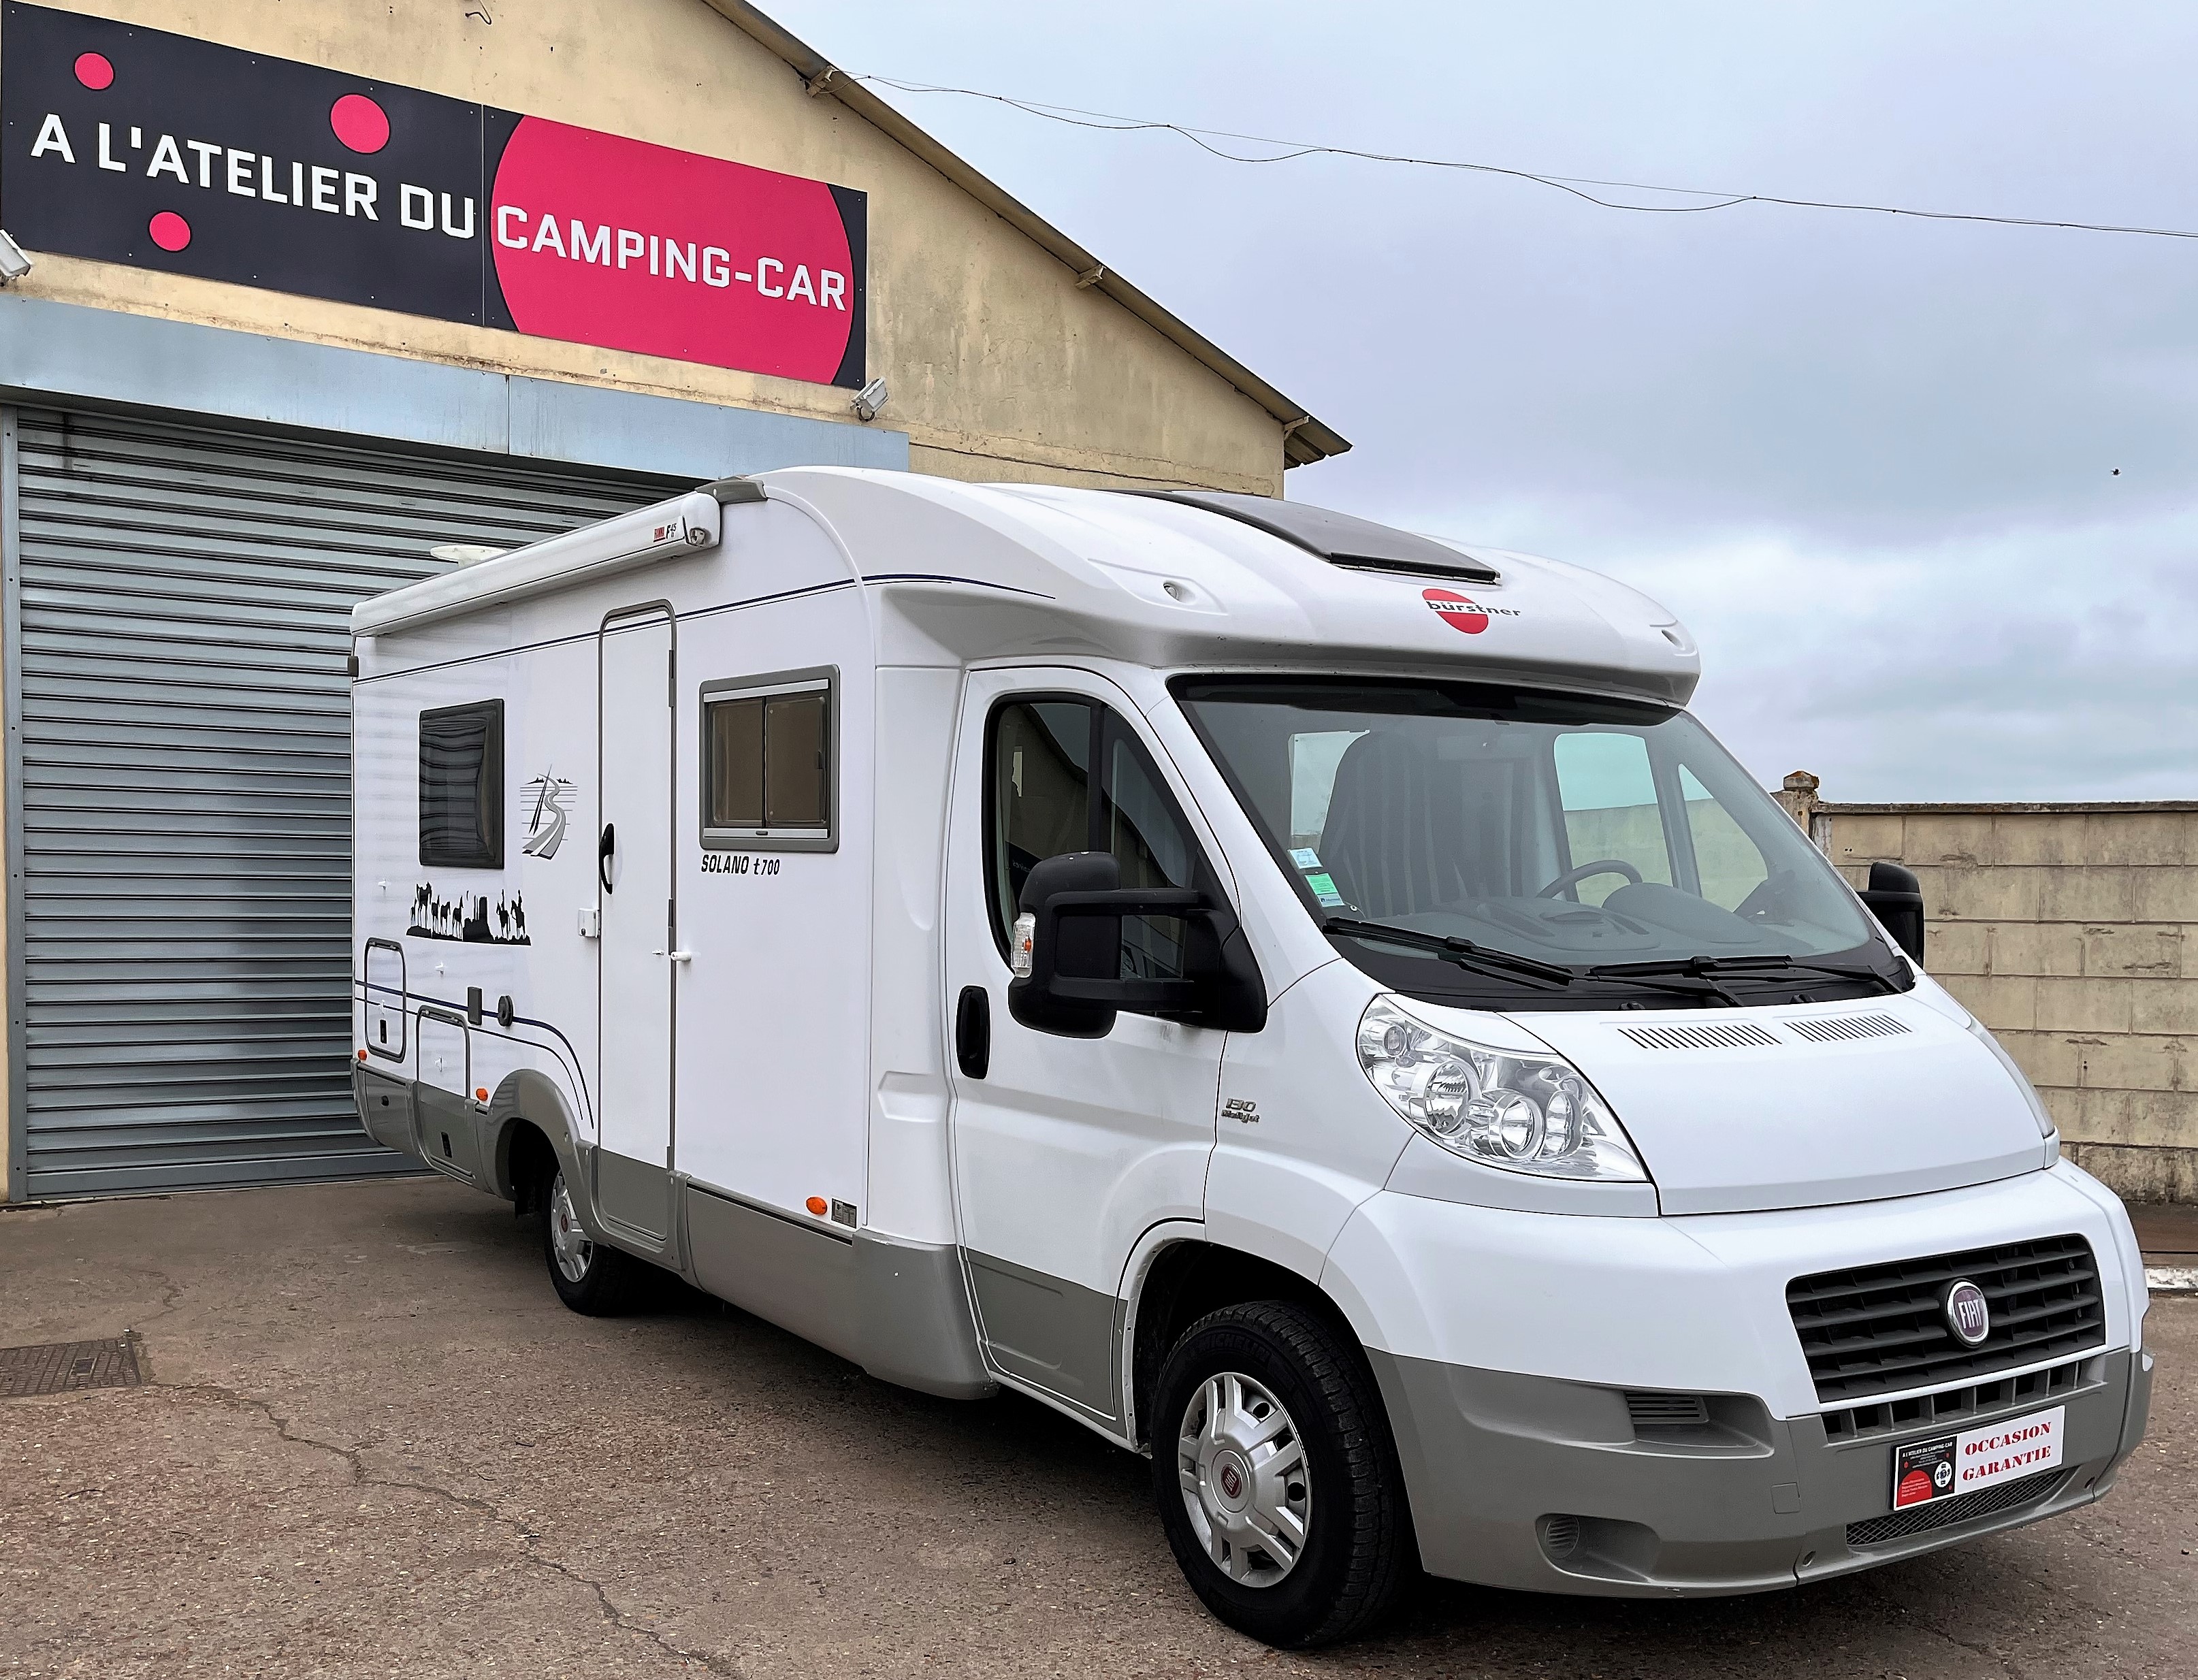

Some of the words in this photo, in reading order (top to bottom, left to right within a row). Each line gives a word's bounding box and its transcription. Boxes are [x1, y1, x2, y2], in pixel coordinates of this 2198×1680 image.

[31, 113, 76, 164] A
[98, 123, 379, 221] L'ATELIER
[400, 183, 475, 239] DU
[497, 205, 846, 311] CAMPING-CAR
[1425, 600, 1521, 617] bürstner
[701, 854, 749, 875] SOLANO
[754, 858, 780, 875] t700
[1958, 1299, 1982, 1329] FIAT
[1965, 1421, 2052, 1456] OCCASION
[1962, 1445, 2052, 1481] GARANTIE
